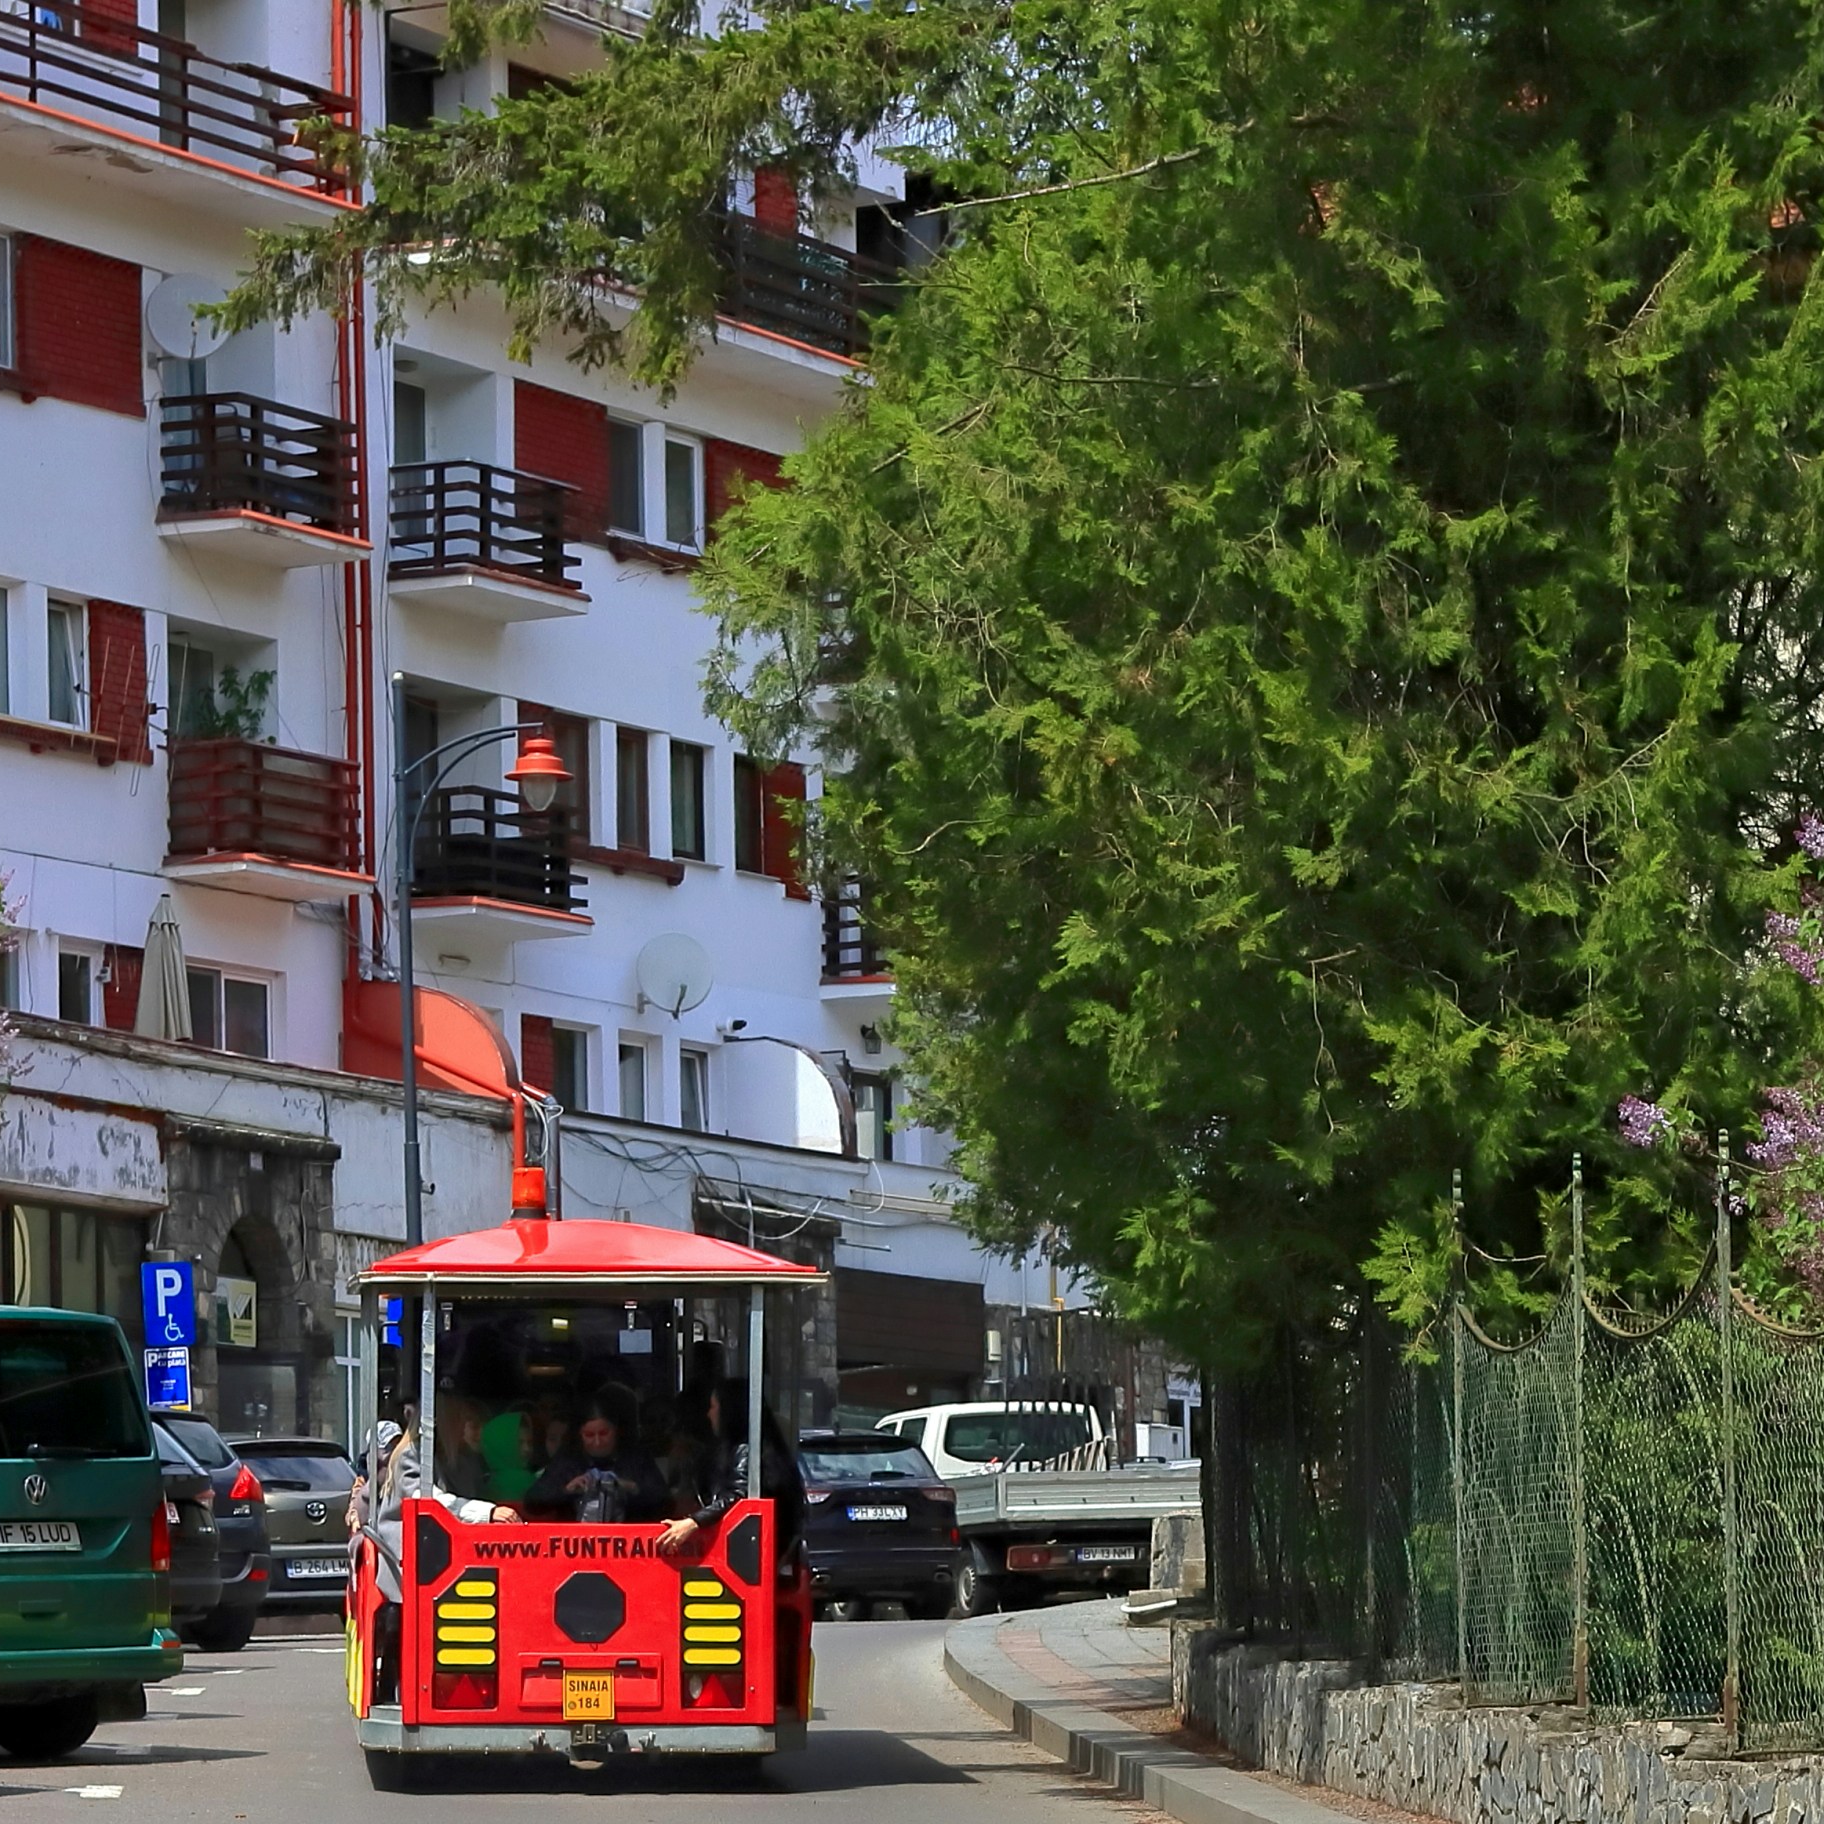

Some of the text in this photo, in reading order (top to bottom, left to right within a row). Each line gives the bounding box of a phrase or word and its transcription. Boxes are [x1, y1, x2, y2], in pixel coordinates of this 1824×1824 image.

[155, 1268, 182, 1317] P
[20, 1524, 36, 1543] 15
[38, 1524, 71, 1543] LUD
[294, 1561, 303, 1574] B
[307, 1561, 329, 1573] 264
[568, 1680, 609, 1692] SINAIA
[578, 1697, 600, 1709] 184
